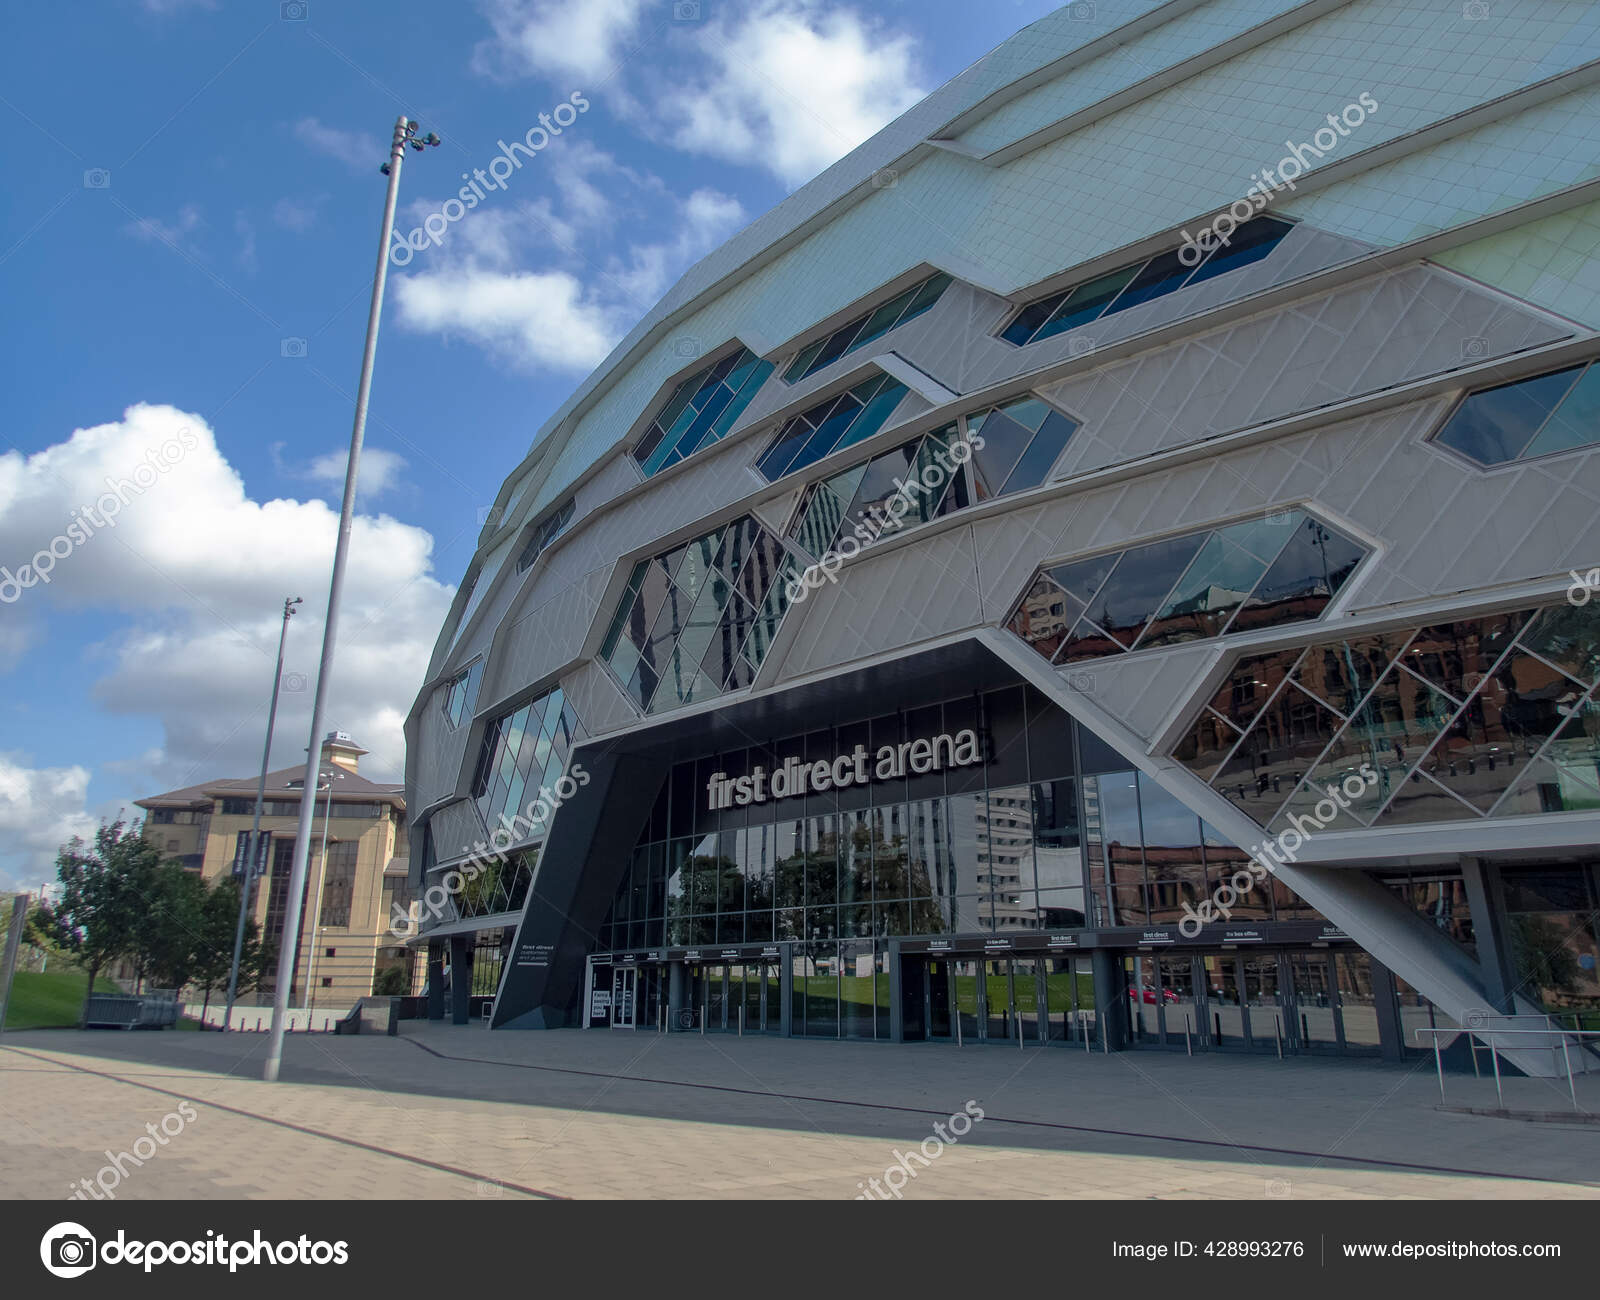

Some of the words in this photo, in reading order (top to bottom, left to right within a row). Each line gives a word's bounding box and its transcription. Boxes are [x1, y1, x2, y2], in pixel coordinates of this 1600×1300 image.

[706, 766, 767, 811] first
[771, 744, 869, 799] direct
[875, 729, 983, 780] arena
